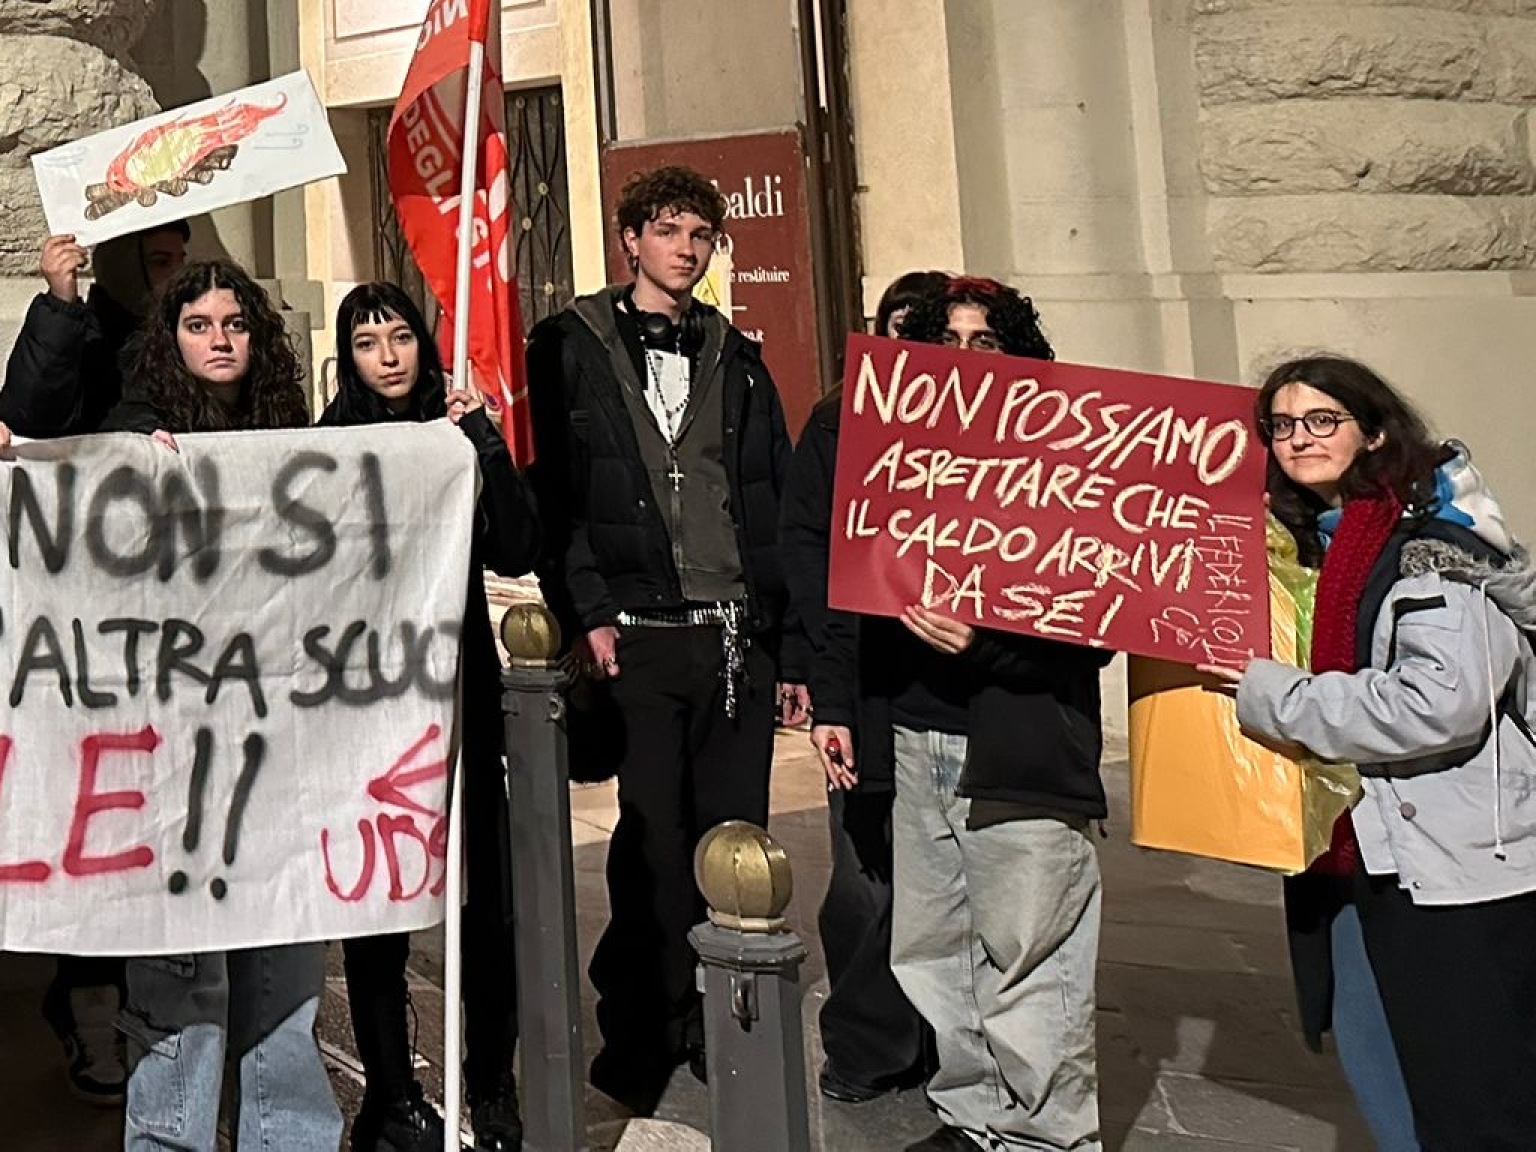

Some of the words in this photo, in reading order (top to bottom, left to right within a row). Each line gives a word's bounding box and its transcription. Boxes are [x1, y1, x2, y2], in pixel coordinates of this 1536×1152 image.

[710, 174, 784, 219] baldi
[738, 265, 790, 282] restituire
[852, 350, 995, 433] NON
[995, 378, 1249, 486] POSSIAMO
[8, 455, 220, 586] NON
[258, 450, 391, 581] SI
[863, 440, 1117, 513] ASPETTARE
[1112, 482, 1210, 535] CHE
[846, 498, 880, 540] IL
[888, 509, 1037, 562] CALDO
[1035, 527, 1196, 593] ARRIVI
[920, 560, 987, 620] DA
[290, 619, 462, 708] SCUO
